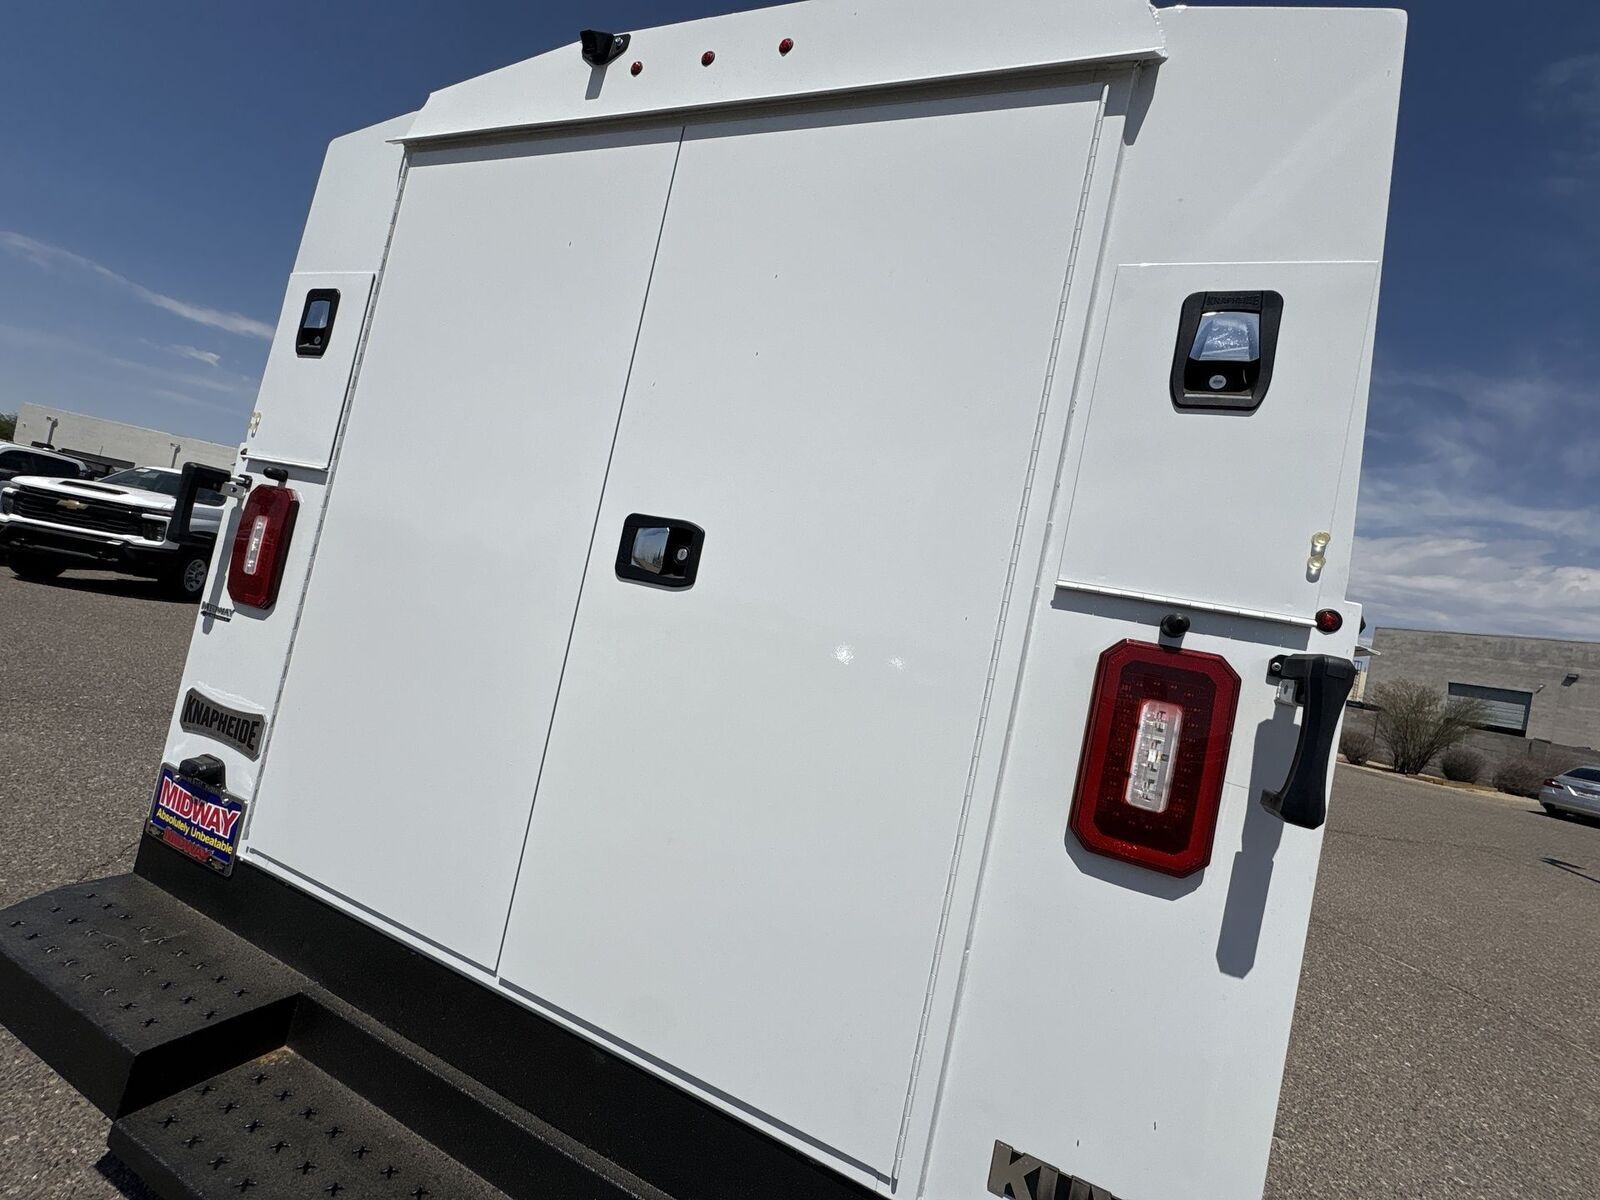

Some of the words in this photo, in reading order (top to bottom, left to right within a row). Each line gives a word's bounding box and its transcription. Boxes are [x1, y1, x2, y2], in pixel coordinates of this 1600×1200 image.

[201, 601, 235, 618] MIDWAY
[183, 695, 261, 751] KNAPHEIDE
[156, 808, 191, 836] Absolutely
[190, 826, 234, 855] Unbeatable
[159, 776, 241, 839] MIDWAY
